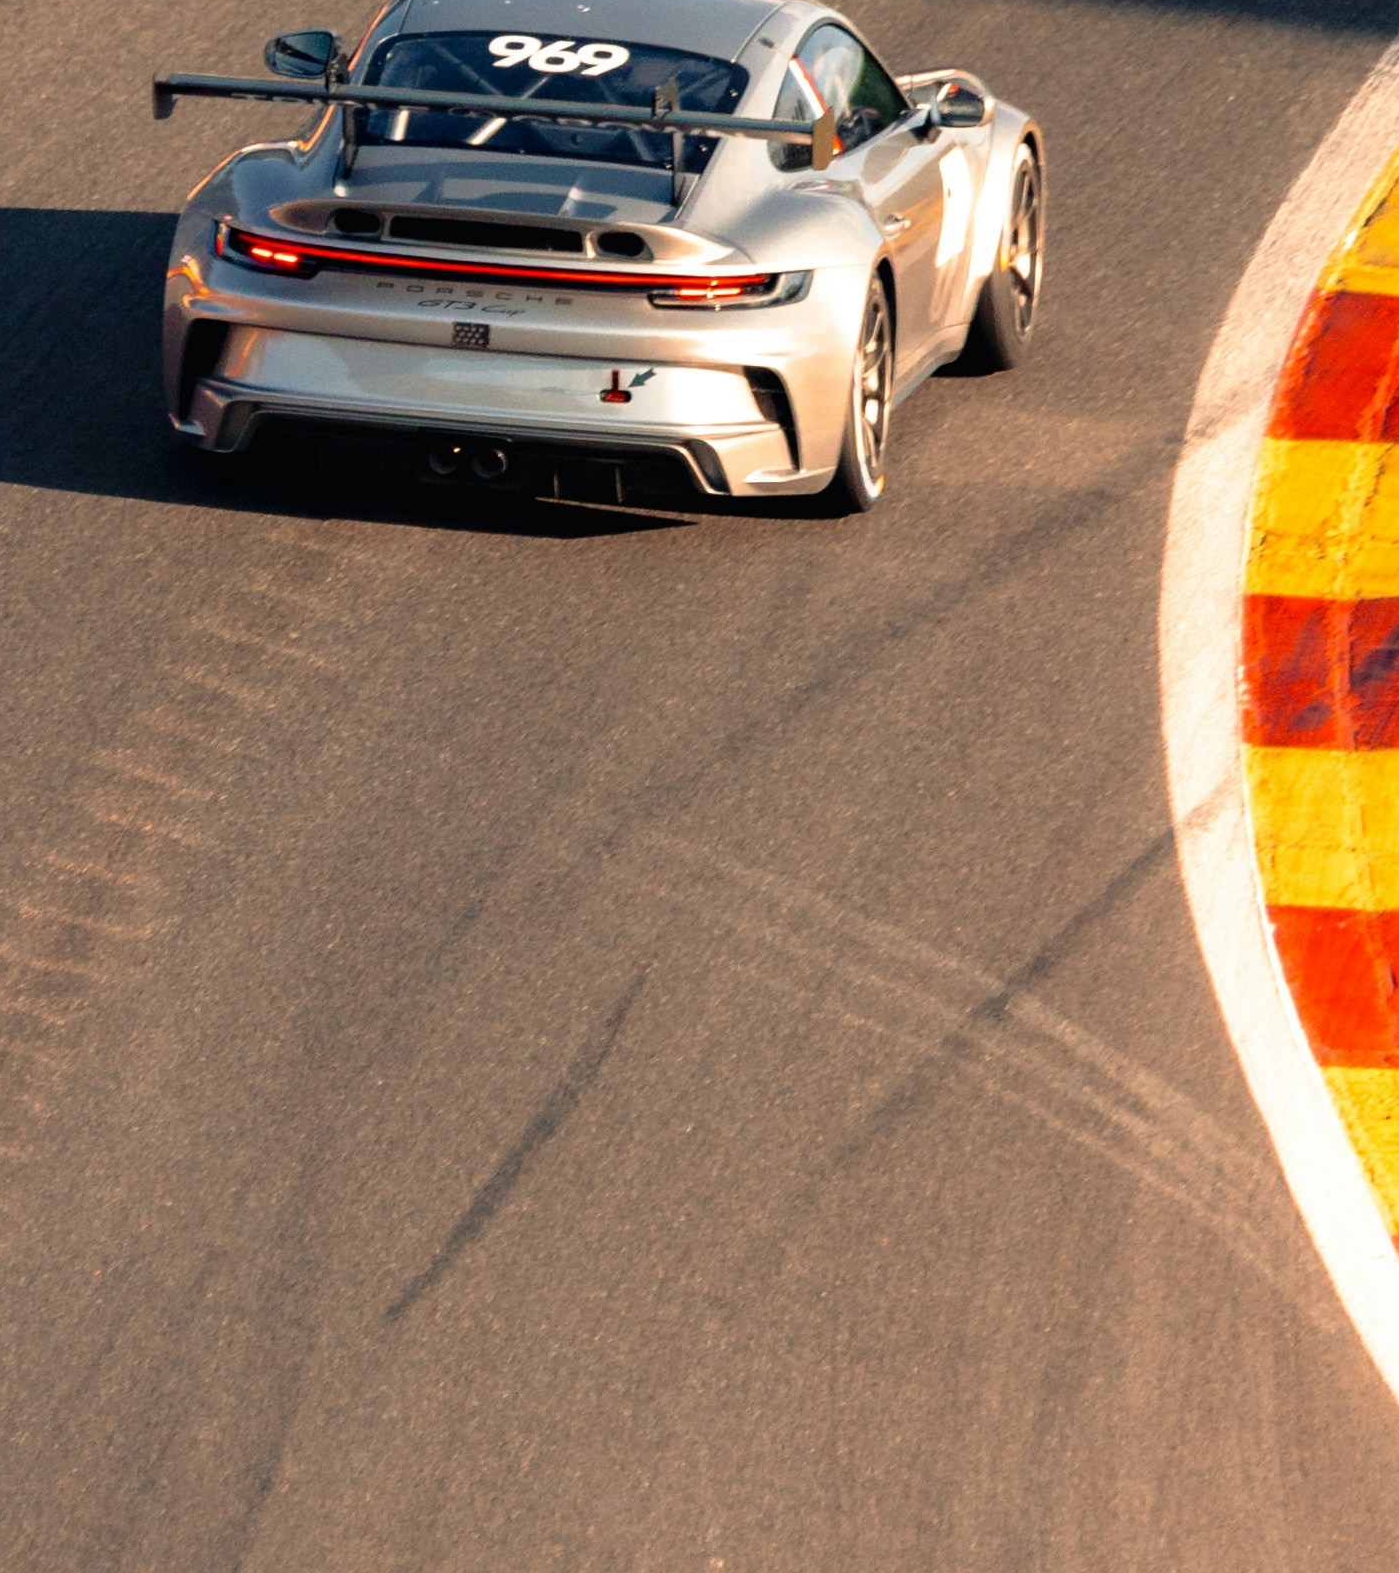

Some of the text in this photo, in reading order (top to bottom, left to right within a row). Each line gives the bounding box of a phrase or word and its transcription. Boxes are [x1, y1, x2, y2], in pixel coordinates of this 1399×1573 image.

[488, 35, 630, 76] 969
[377, 281, 572, 305] PORSCHE
[417, 299, 477, 310] GT3
